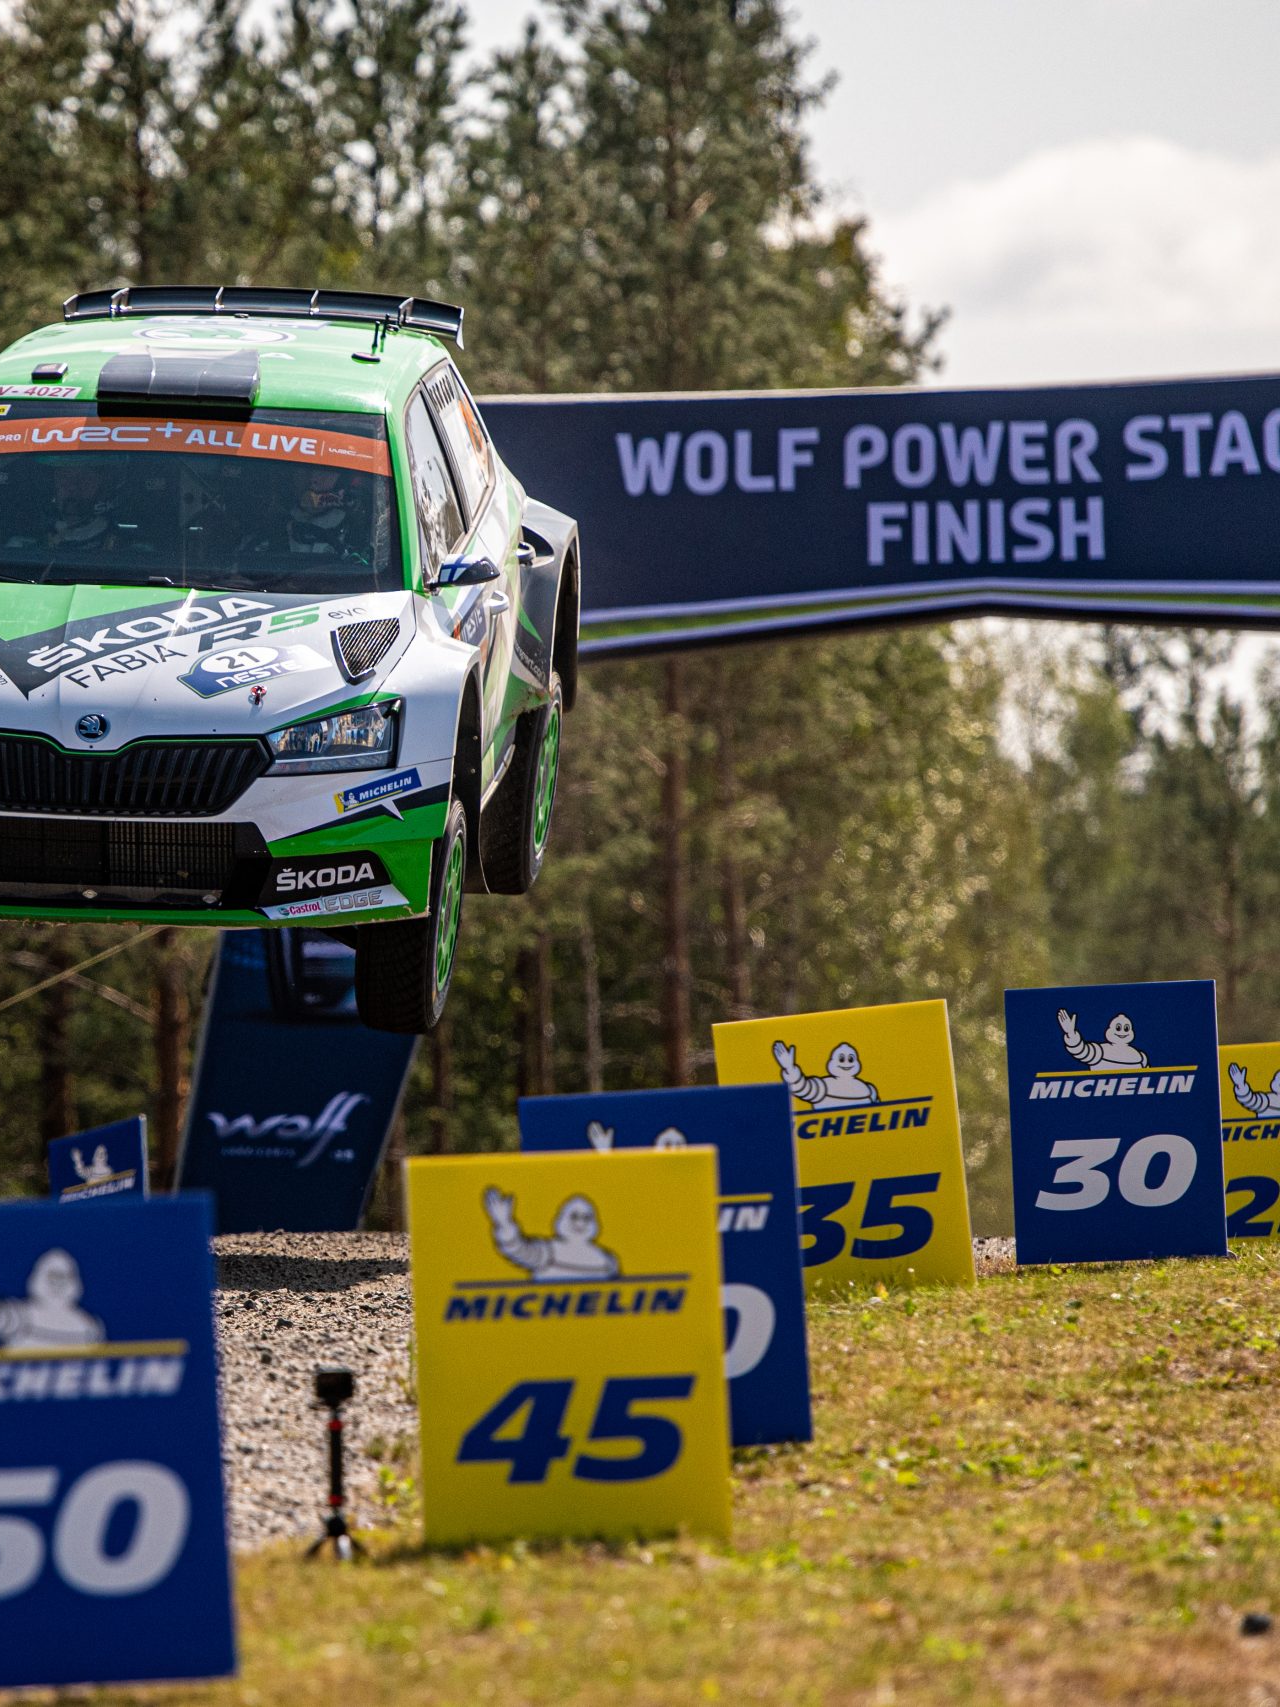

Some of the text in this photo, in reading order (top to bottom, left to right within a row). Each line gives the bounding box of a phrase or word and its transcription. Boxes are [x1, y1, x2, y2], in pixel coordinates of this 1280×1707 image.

[185, 428, 242, 448] ALL
[251, 432, 318, 456] LIVE
[615, 427, 820, 497] WOLF
[843, 418, 1102, 489] POWER
[866, 496, 1107, 566] FINISH
[26, 597, 276, 674] ŠKODA
[63, 643, 189, 689] FABIA
[197, 605, 320, 653] R5
[215, 650, 261, 670] 21
[359, 775, 413, 801] MICHELIN
[275, 861, 376, 893] ŠKODA
[288, 889, 385, 917] Castrol EDGE
[1028, 1074, 1196, 1100] MICHELIN
[1034, 1133, 1198, 1211] 30
[801, 1171, 942, 1268] 35
[1225, 1175, 1280, 1238] 2
[442, 1286, 688, 1324] MICHELIN
[455, 1374, 697, 1485] 45
